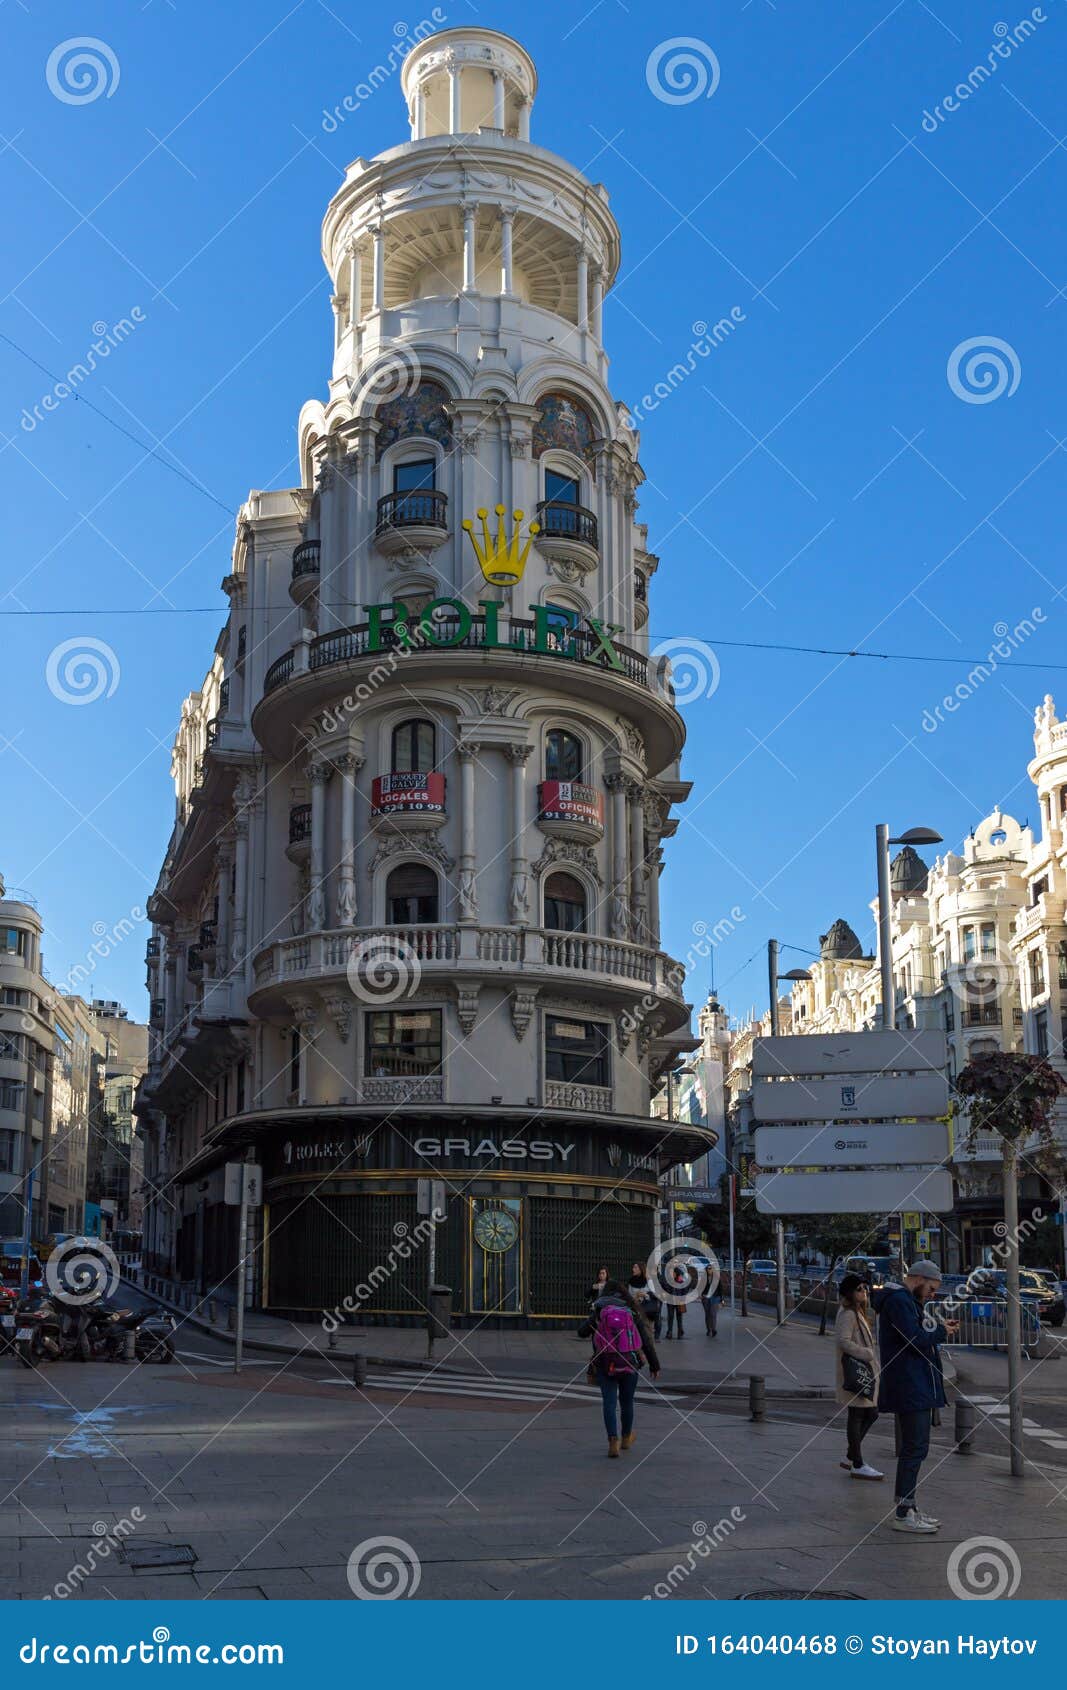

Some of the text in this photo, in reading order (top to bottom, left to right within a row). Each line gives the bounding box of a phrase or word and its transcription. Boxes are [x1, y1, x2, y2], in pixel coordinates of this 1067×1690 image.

[363, 597, 626, 672] ROLEX
[380, 792, 429, 804] LOCALES
[409, 802, 424, 811] 10
[427, 803, 442, 812] 99
[545, 811, 560, 819] 91
[564, 812, 585, 822] 524
[296, 1142, 346, 1160] ROLEX
[414, 1137, 576, 1161] GRASSY
[668, 1190, 718, 1199] GRASSY
